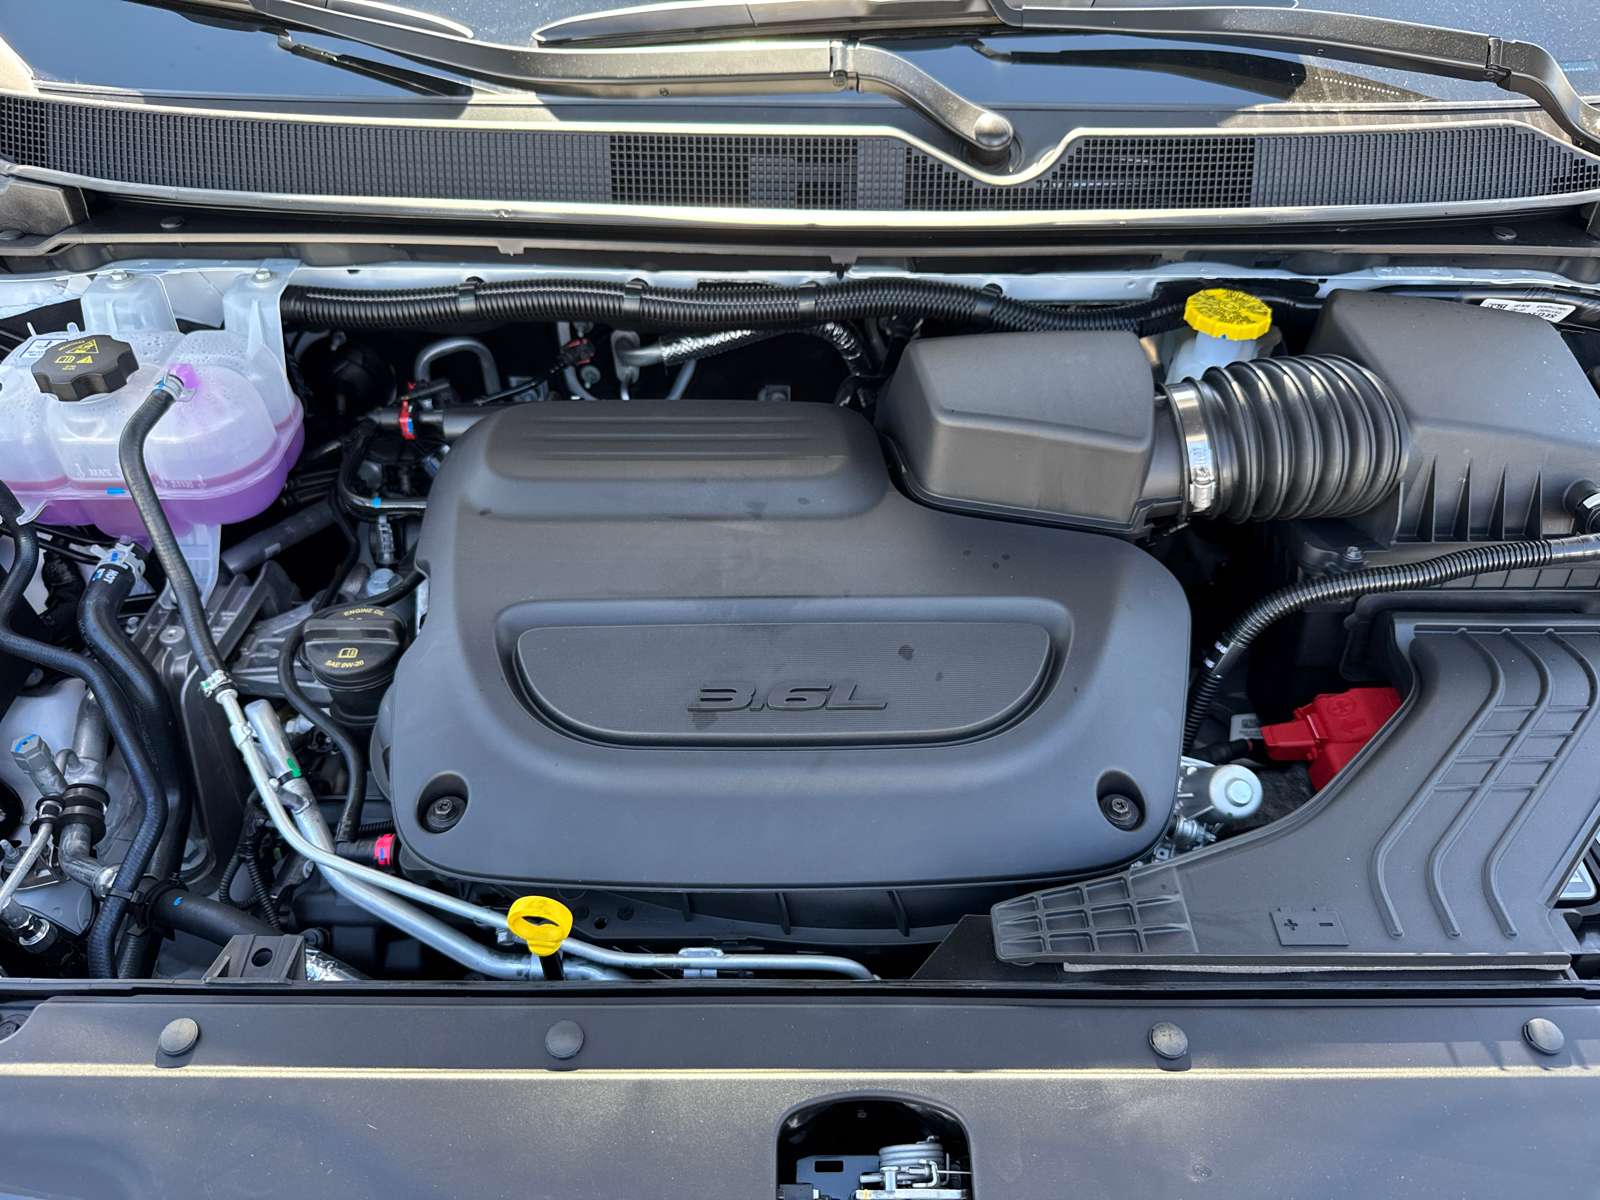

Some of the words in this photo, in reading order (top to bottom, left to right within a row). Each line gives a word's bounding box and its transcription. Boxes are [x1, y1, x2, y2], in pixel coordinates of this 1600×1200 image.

[103, 569, 119, 585] HOT
[343, 608, 374, 617] ENGINE
[325, 659, 341, 668] SAE
[341, 660, 365, 668] 0W-20
[687, 681, 888, 712] 3.6L
